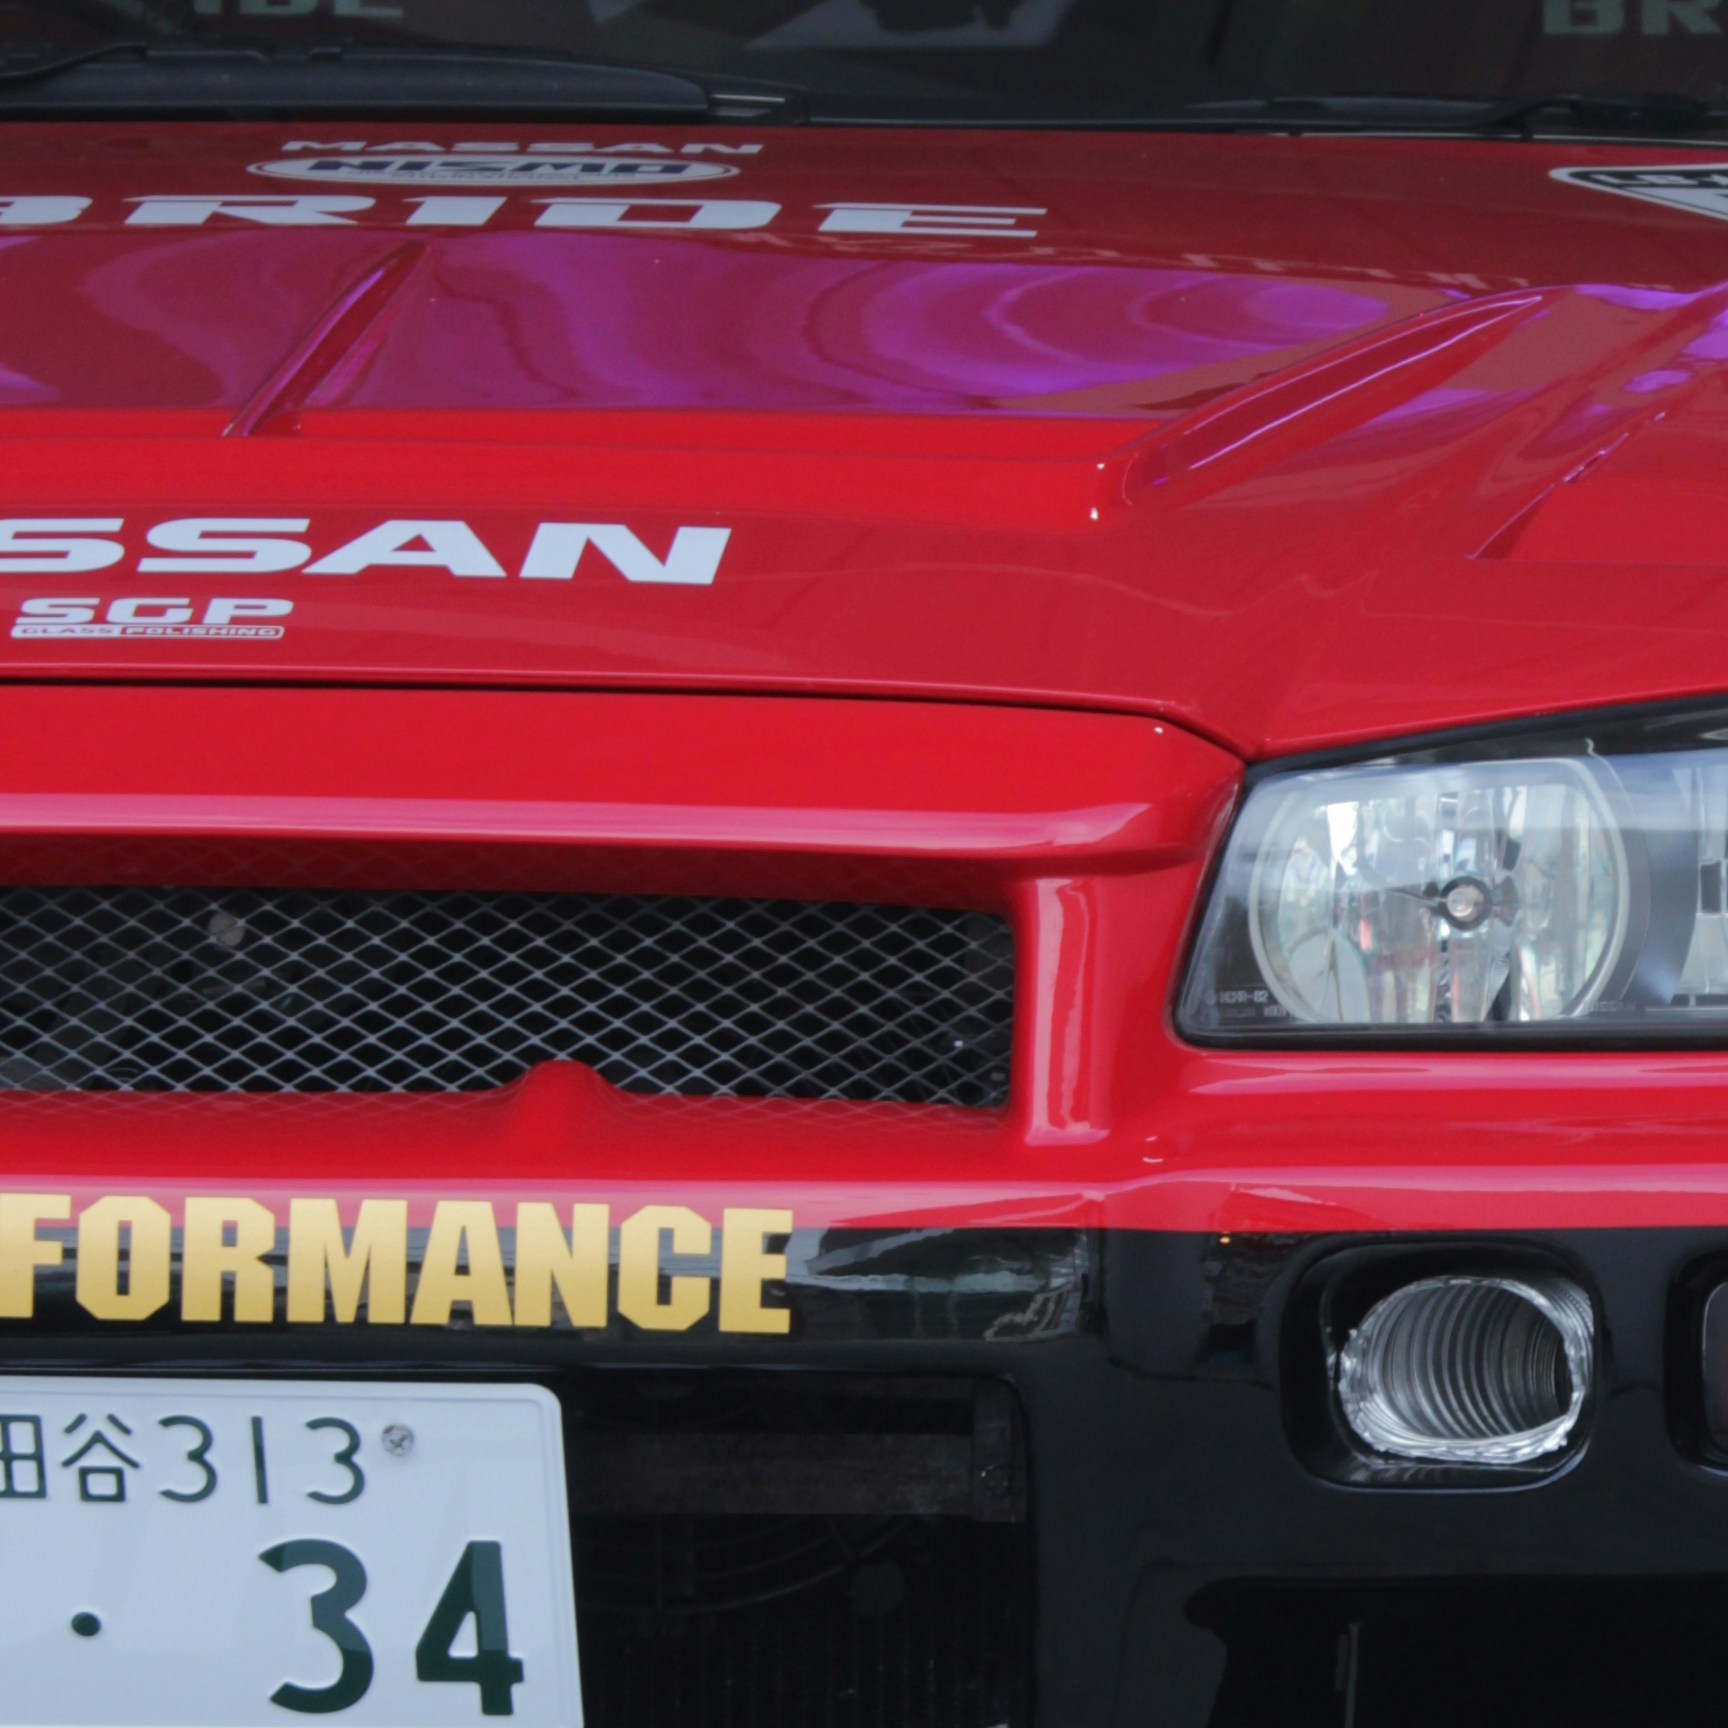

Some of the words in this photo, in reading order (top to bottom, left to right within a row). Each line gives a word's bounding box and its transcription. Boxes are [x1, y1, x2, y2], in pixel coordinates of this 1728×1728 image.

[14, 597, 295, 625] SGP
[20, 627, 115, 635] GLASS
[124, 626, 281, 636] POLISHING
[0, 1192, 794, 1335] FORMANCE
